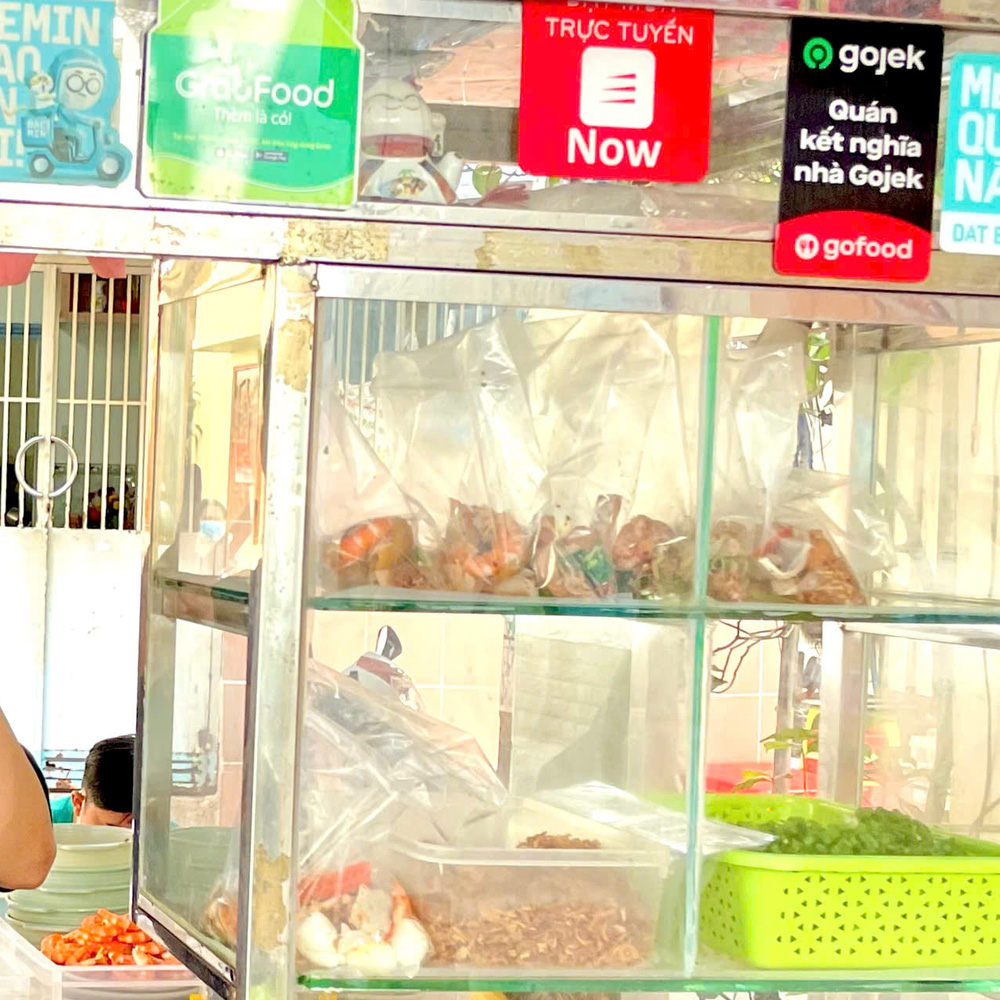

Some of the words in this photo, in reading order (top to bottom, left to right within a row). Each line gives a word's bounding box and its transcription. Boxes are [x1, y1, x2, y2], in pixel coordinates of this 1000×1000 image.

[545, 16, 610, 43] TRỰC
[617, 17, 694, 45] TUYẾN
[838, 43, 926, 76] gojek
[175, 64, 335, 109] GrabFood
[828, 99, 898, 124] Quán
[568, 128, 662, 168] Now
[799, 126, 846, 152] kết
[848, 133, 923, 161] nghĩa
[794, 160, 845, 185] nhà
[848, 163, 925, 194] Gojek
[822, 236, 914, 261] gofood
